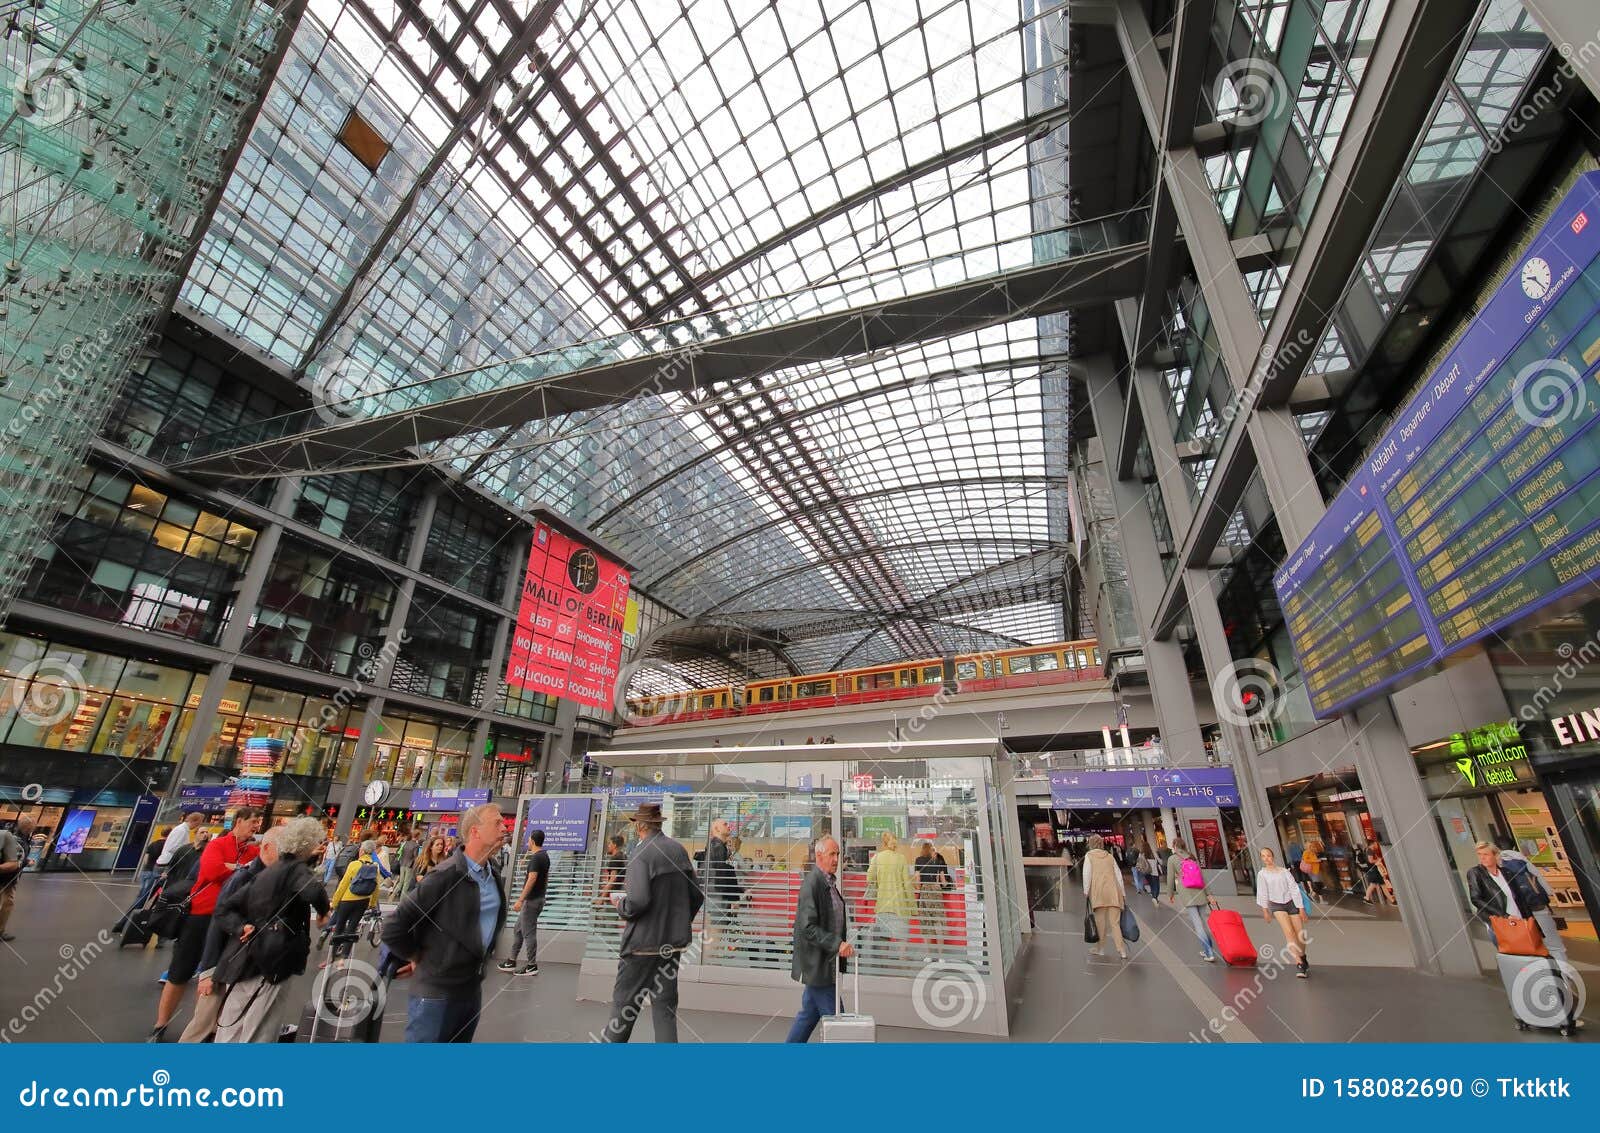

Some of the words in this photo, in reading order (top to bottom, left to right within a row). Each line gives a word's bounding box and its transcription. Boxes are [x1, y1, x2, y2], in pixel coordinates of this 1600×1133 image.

[1571, 212, 1588, 234] DB
[1524, 303, 1541, 324] Gleis
[1588, 400, 1598, 415] 2
[1370, 438, 1399, 476] Abfahrt
[1399, 401, 1431, 442] Departure
[1517, 459, 1565, 501] Ludwigsfelde
[1523, 480, 1567, 513] Magdeburg
[1533, 513, 1558, 534] Nauen
[525, 579, 560, 607] MALL
[565, 597, 584, 613] OF
[586, 606, 624, 634] BERLIN
[530, 612, 552, 630] BEST
[557, 623, 573, 636] OF
[576, 629, 614, 653] SHOPPING
[516, 636, 543, 655] MORE
[546, 647, 573, 664] THAN
[573, 655, 587, 670] 300
[589, 662, 616, 679] SHOPS
[513, 665, 565, 690] DELICIOUS
[567, 681, 608, 702] FOODHALL
[1189, 786, 1214, 797] 11-16
[1486, 766, 1518, 785] debitel
